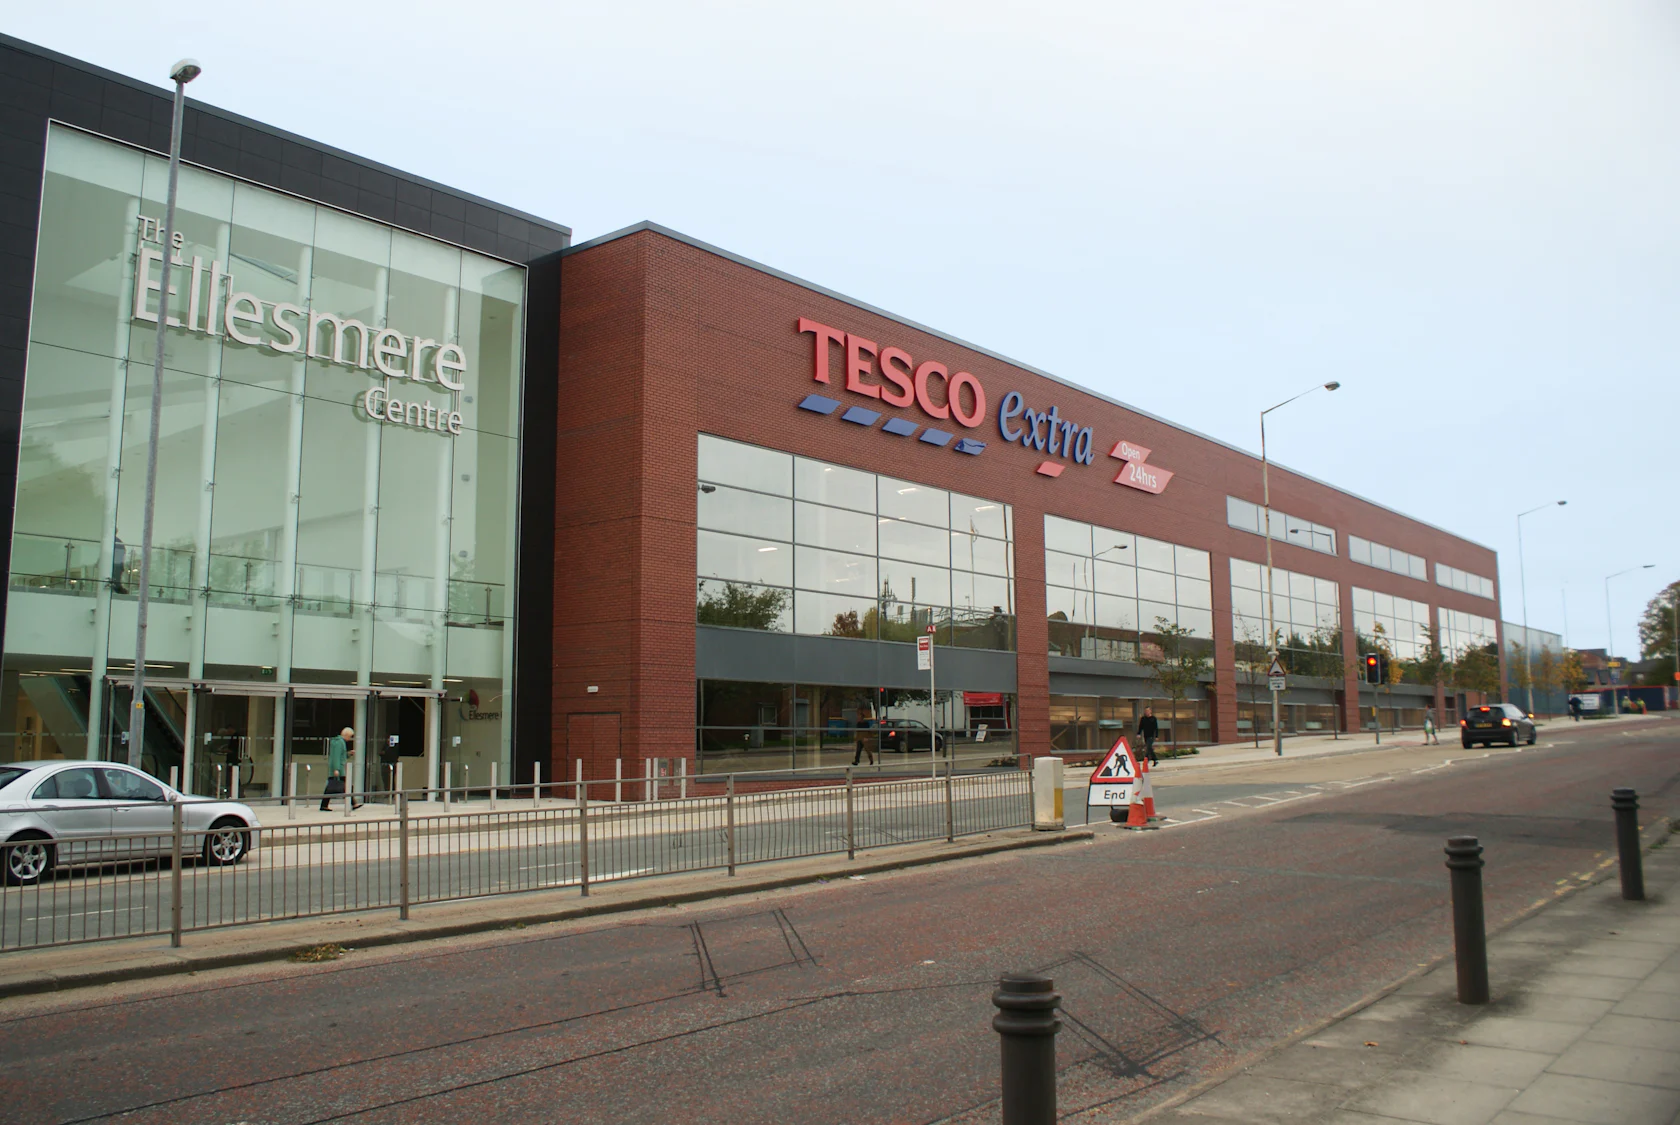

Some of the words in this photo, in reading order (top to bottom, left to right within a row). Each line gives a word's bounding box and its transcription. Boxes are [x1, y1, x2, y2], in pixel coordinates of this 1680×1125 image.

[136, 214, 184, 249] The
[134, 248, 467, 391] Ellesmere
[798, 317, 986, 428] TESCO
[364, 386, 464, 435] Centre
[1000, 391, 1094, 465] extra
[1121, 442, 1141, 459] Open
[1129, 463, 1157, 488] 24hrs
[1104, 789, 1126, 800] End
